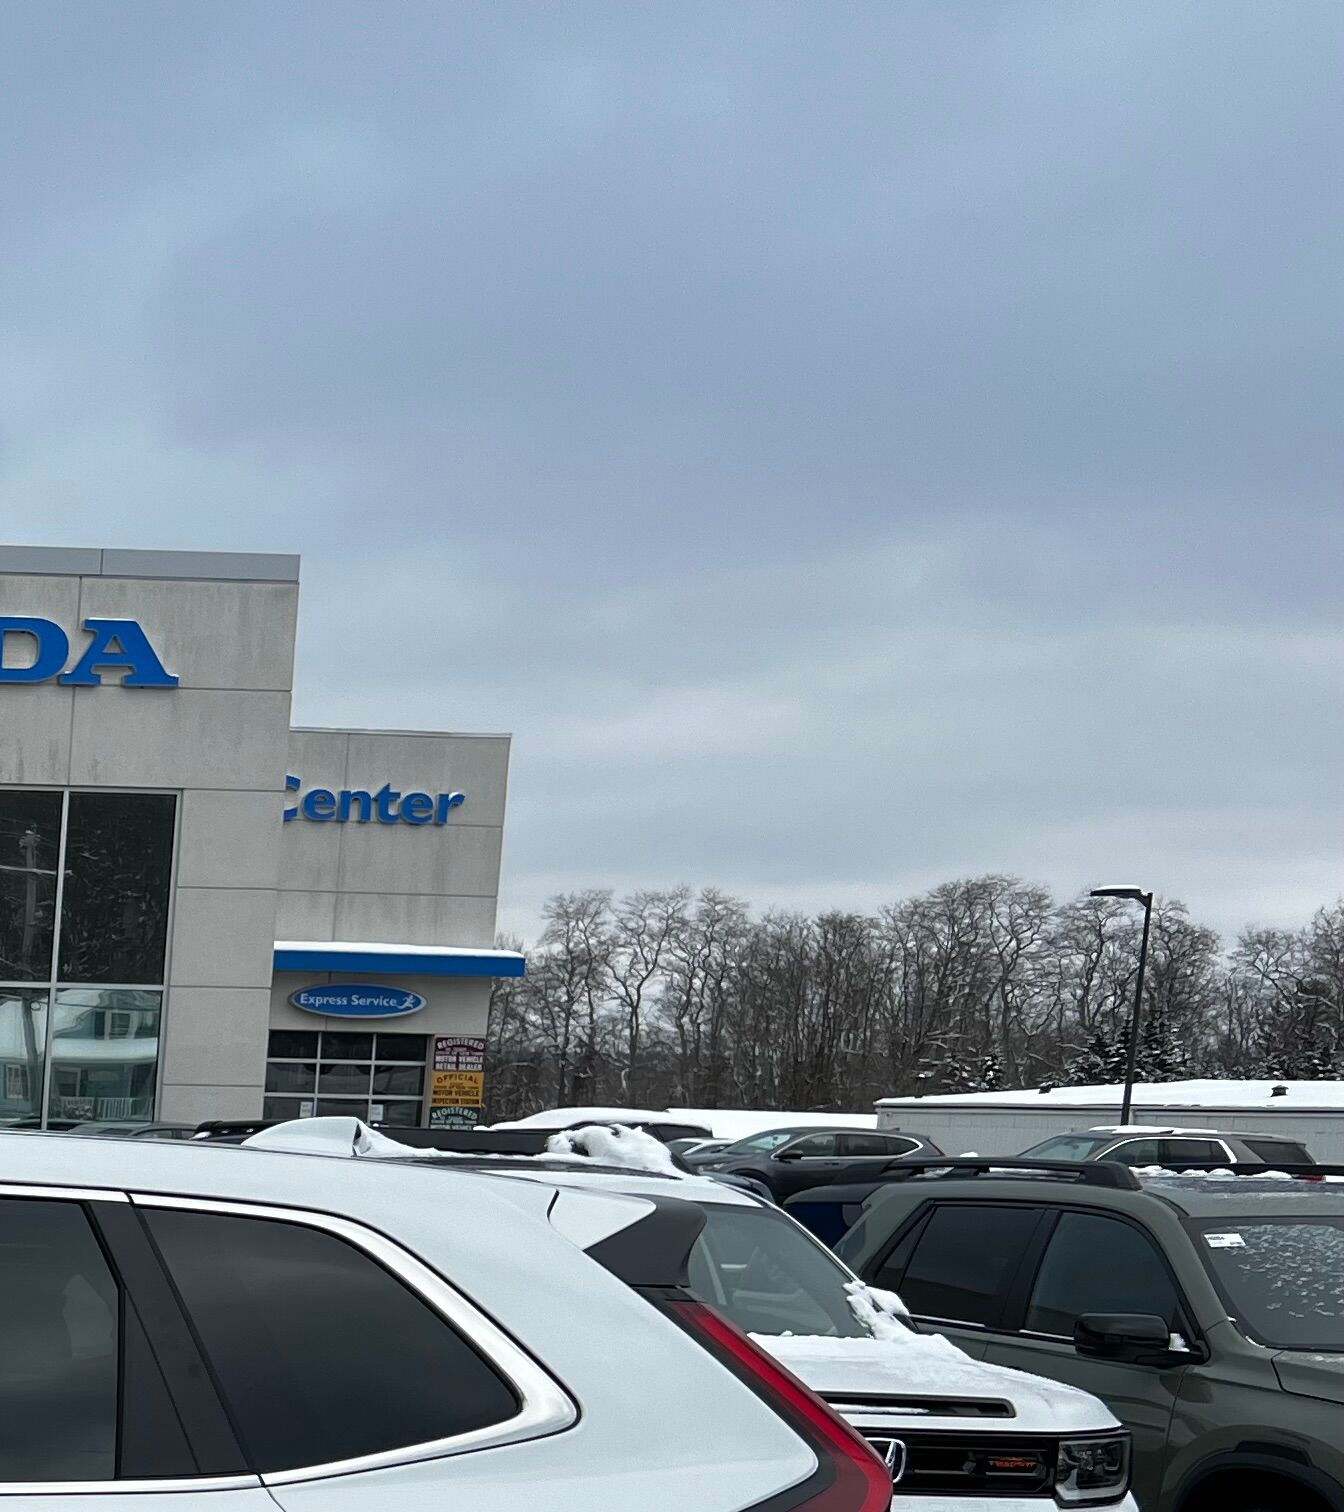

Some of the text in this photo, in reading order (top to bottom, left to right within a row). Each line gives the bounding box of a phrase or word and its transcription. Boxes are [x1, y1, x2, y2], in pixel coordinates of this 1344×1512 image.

[299, 993, 397, 1007] Express Service
[437, 1038, 484, 1050] REGISTERED
[436, 1074, 478, 1084] OFFICIAL
[431, 1107, 478, 1120] REGISTERED
